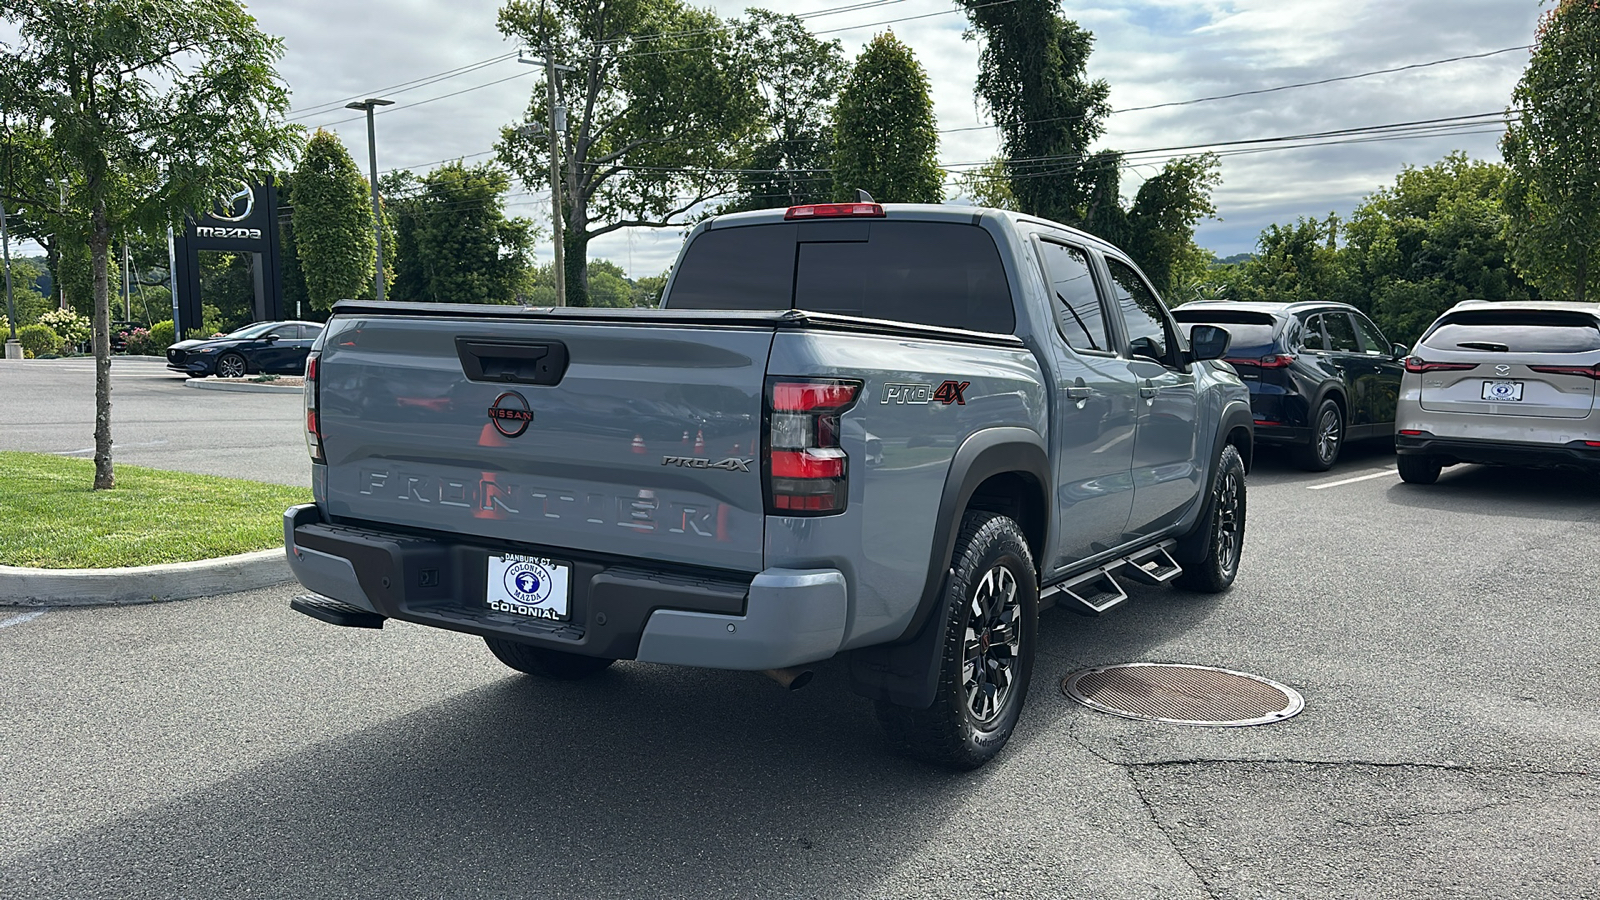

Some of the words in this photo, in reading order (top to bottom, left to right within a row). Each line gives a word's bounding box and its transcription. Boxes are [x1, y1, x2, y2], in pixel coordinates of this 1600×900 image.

[488, 408, 532, 421] NISSAN
[661, 455, 754, 473] PRO-4X
[360, 468, 712, 536] FRONTIER
[510, 564, 546, 581] COLONIAL
[514, 589, 541, 602] MAZDA
[491, 602, 559, 620] COLONIAL
